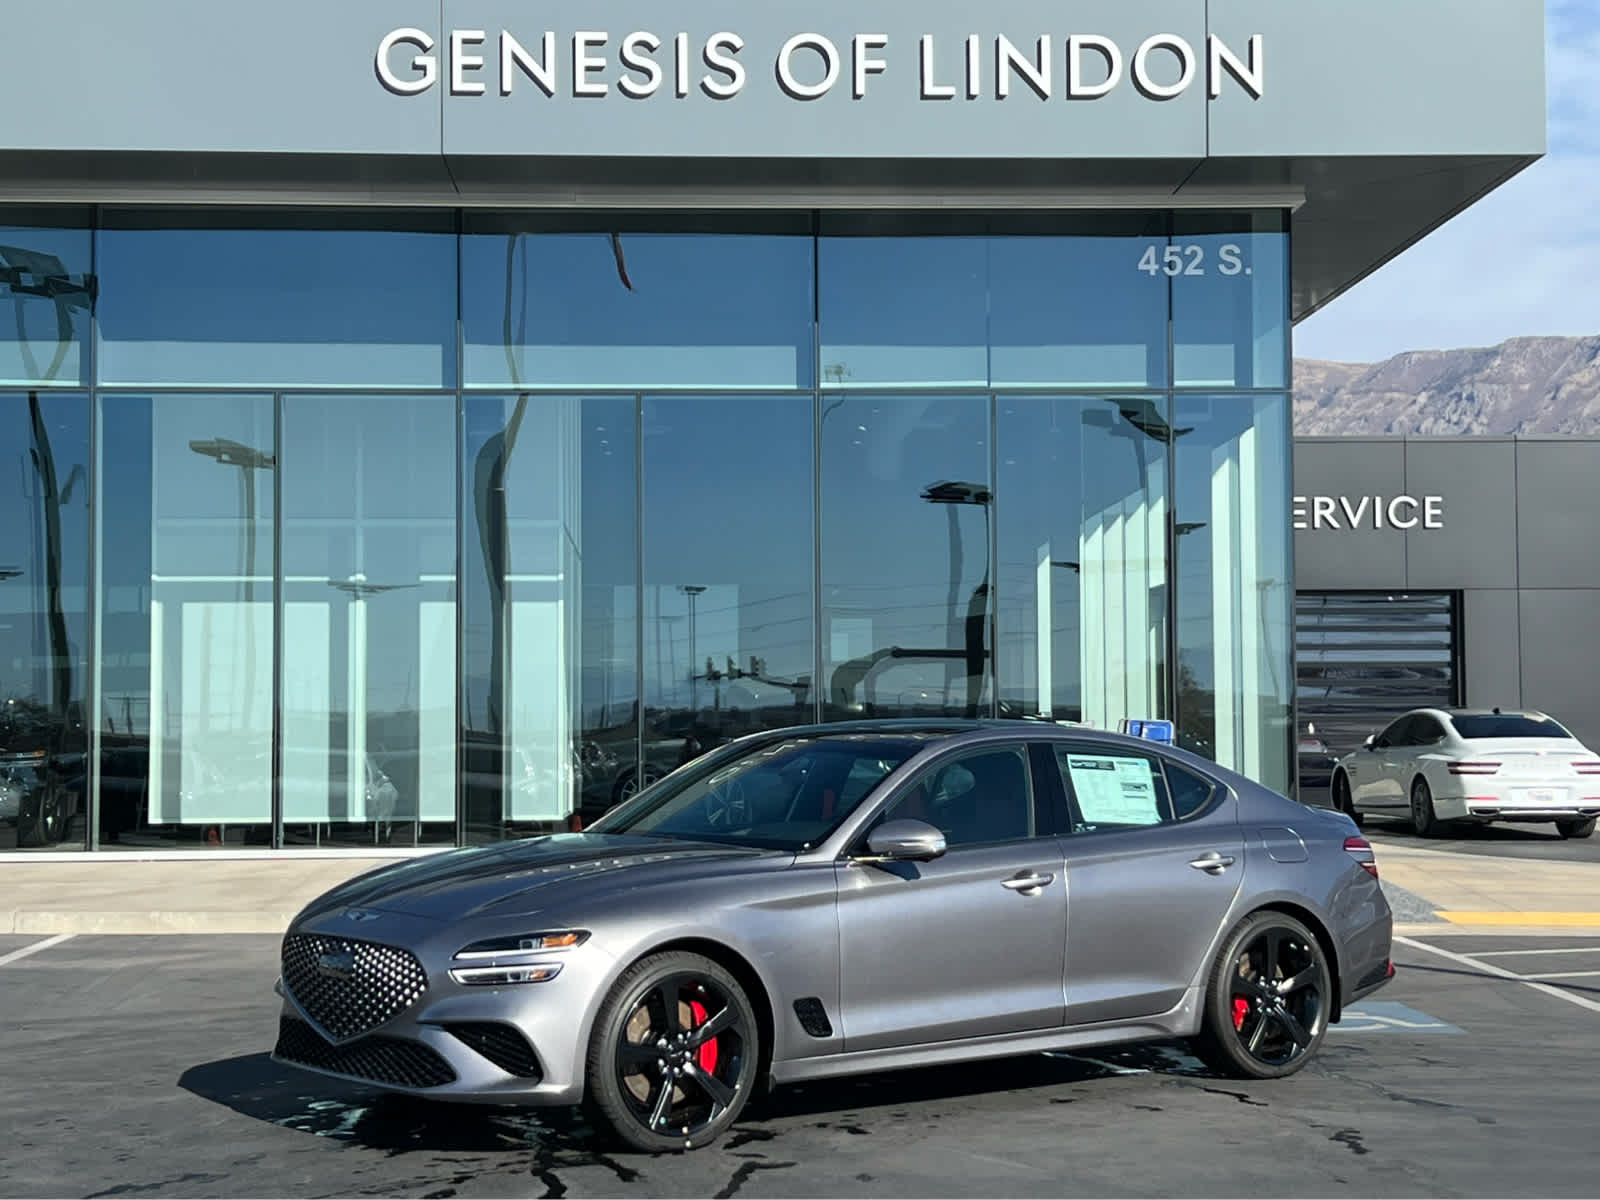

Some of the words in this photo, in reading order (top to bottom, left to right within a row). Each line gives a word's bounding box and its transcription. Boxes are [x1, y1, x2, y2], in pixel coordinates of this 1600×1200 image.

[375, 27, 745, 99] GENESIS
[775, 32, 888, 100] OF
[919, 33, 1264, 101] LINDON
[1138, 245, 1204, 276] 452
[1218, 244, 1252, 276] S.
[1293, 495, 1443, 529] ERVICE
